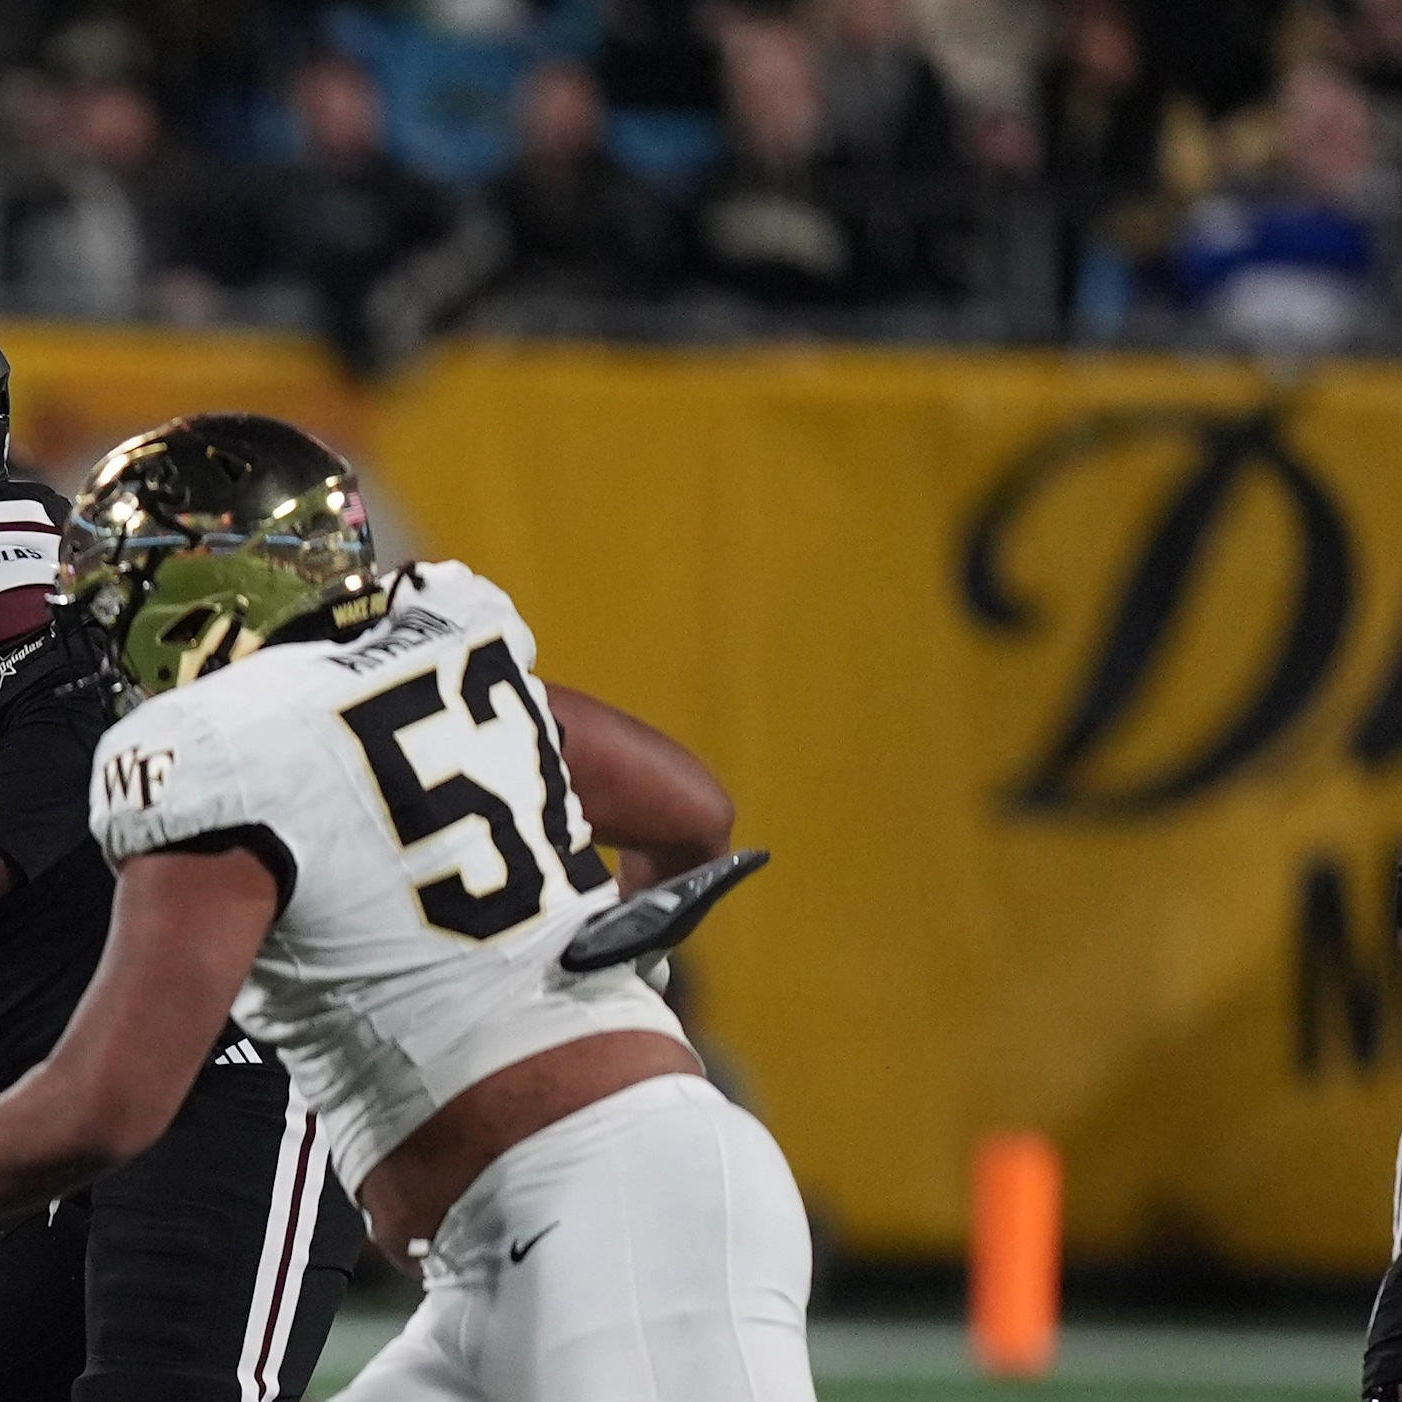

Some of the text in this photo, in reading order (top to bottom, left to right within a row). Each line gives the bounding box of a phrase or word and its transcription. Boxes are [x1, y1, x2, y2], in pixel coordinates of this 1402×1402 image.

[950, 405, 1402, 835] D
[104, 746, 175, 811] WF
[339, 637, 612, 939] 52
